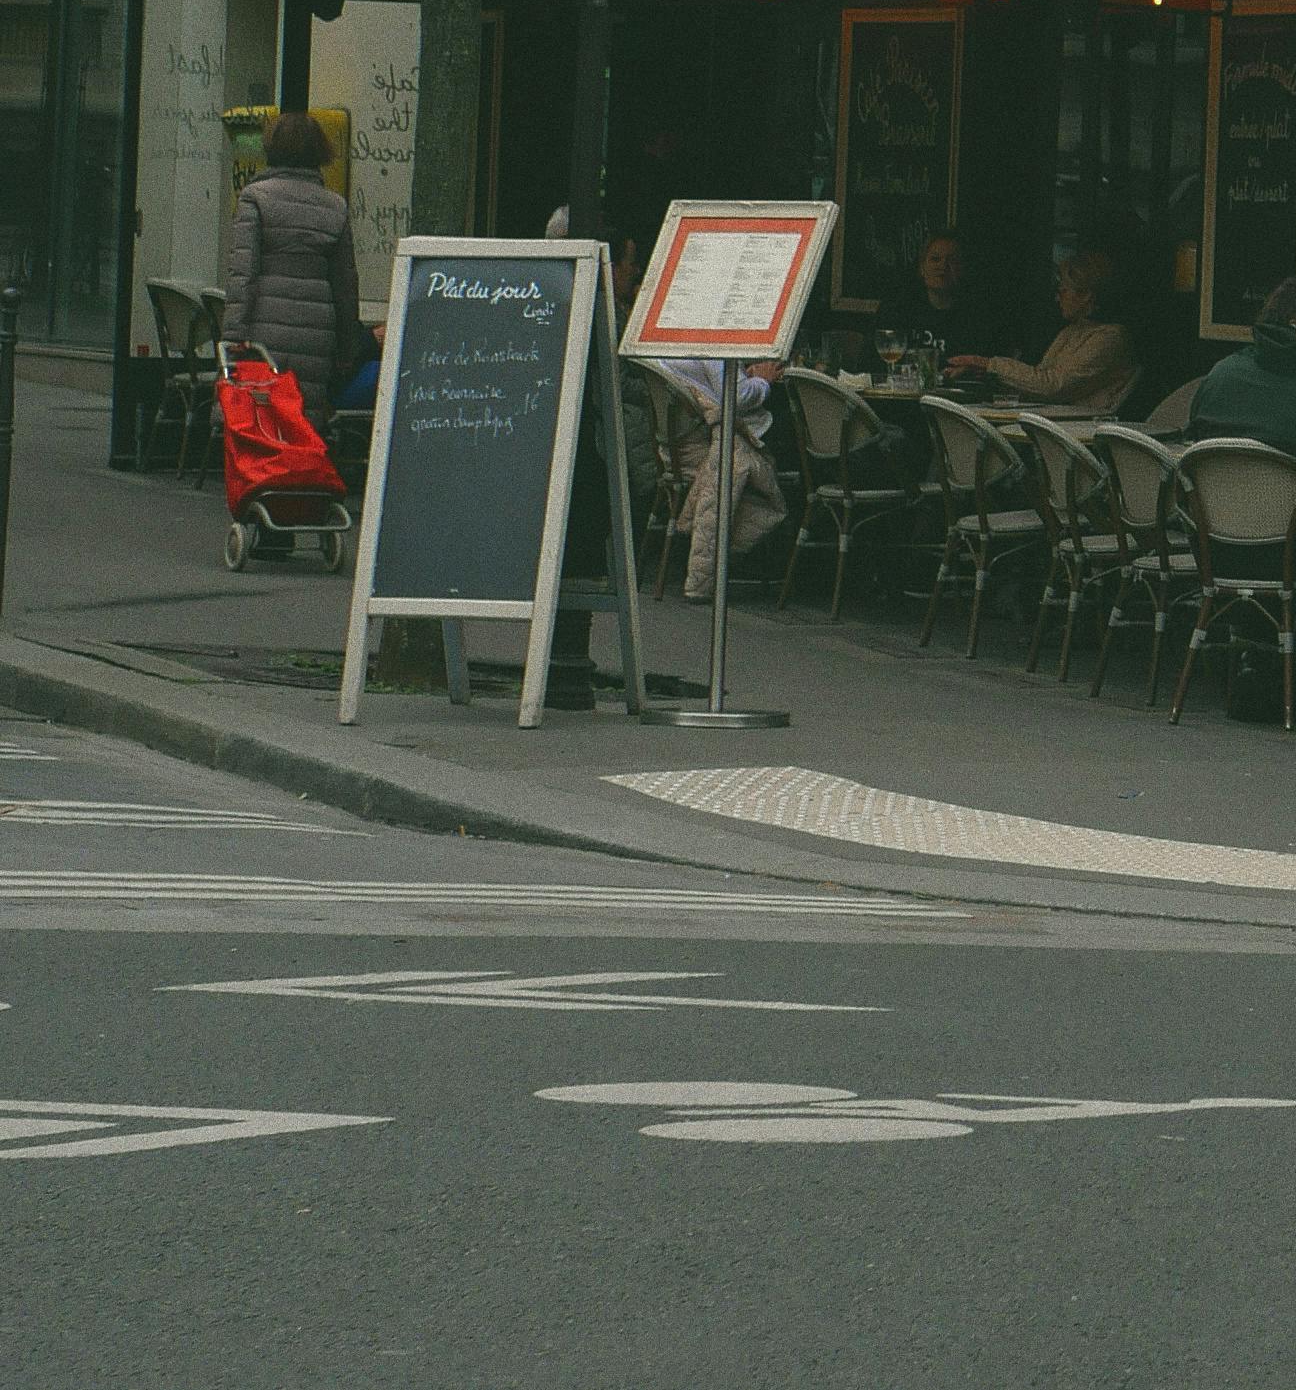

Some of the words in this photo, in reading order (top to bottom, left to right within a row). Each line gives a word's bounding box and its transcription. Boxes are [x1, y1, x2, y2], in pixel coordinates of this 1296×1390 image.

[427, 272, 467, 298] Plat
[466, 280, 491, 299] du
[490, 277, 542, 305] jour
